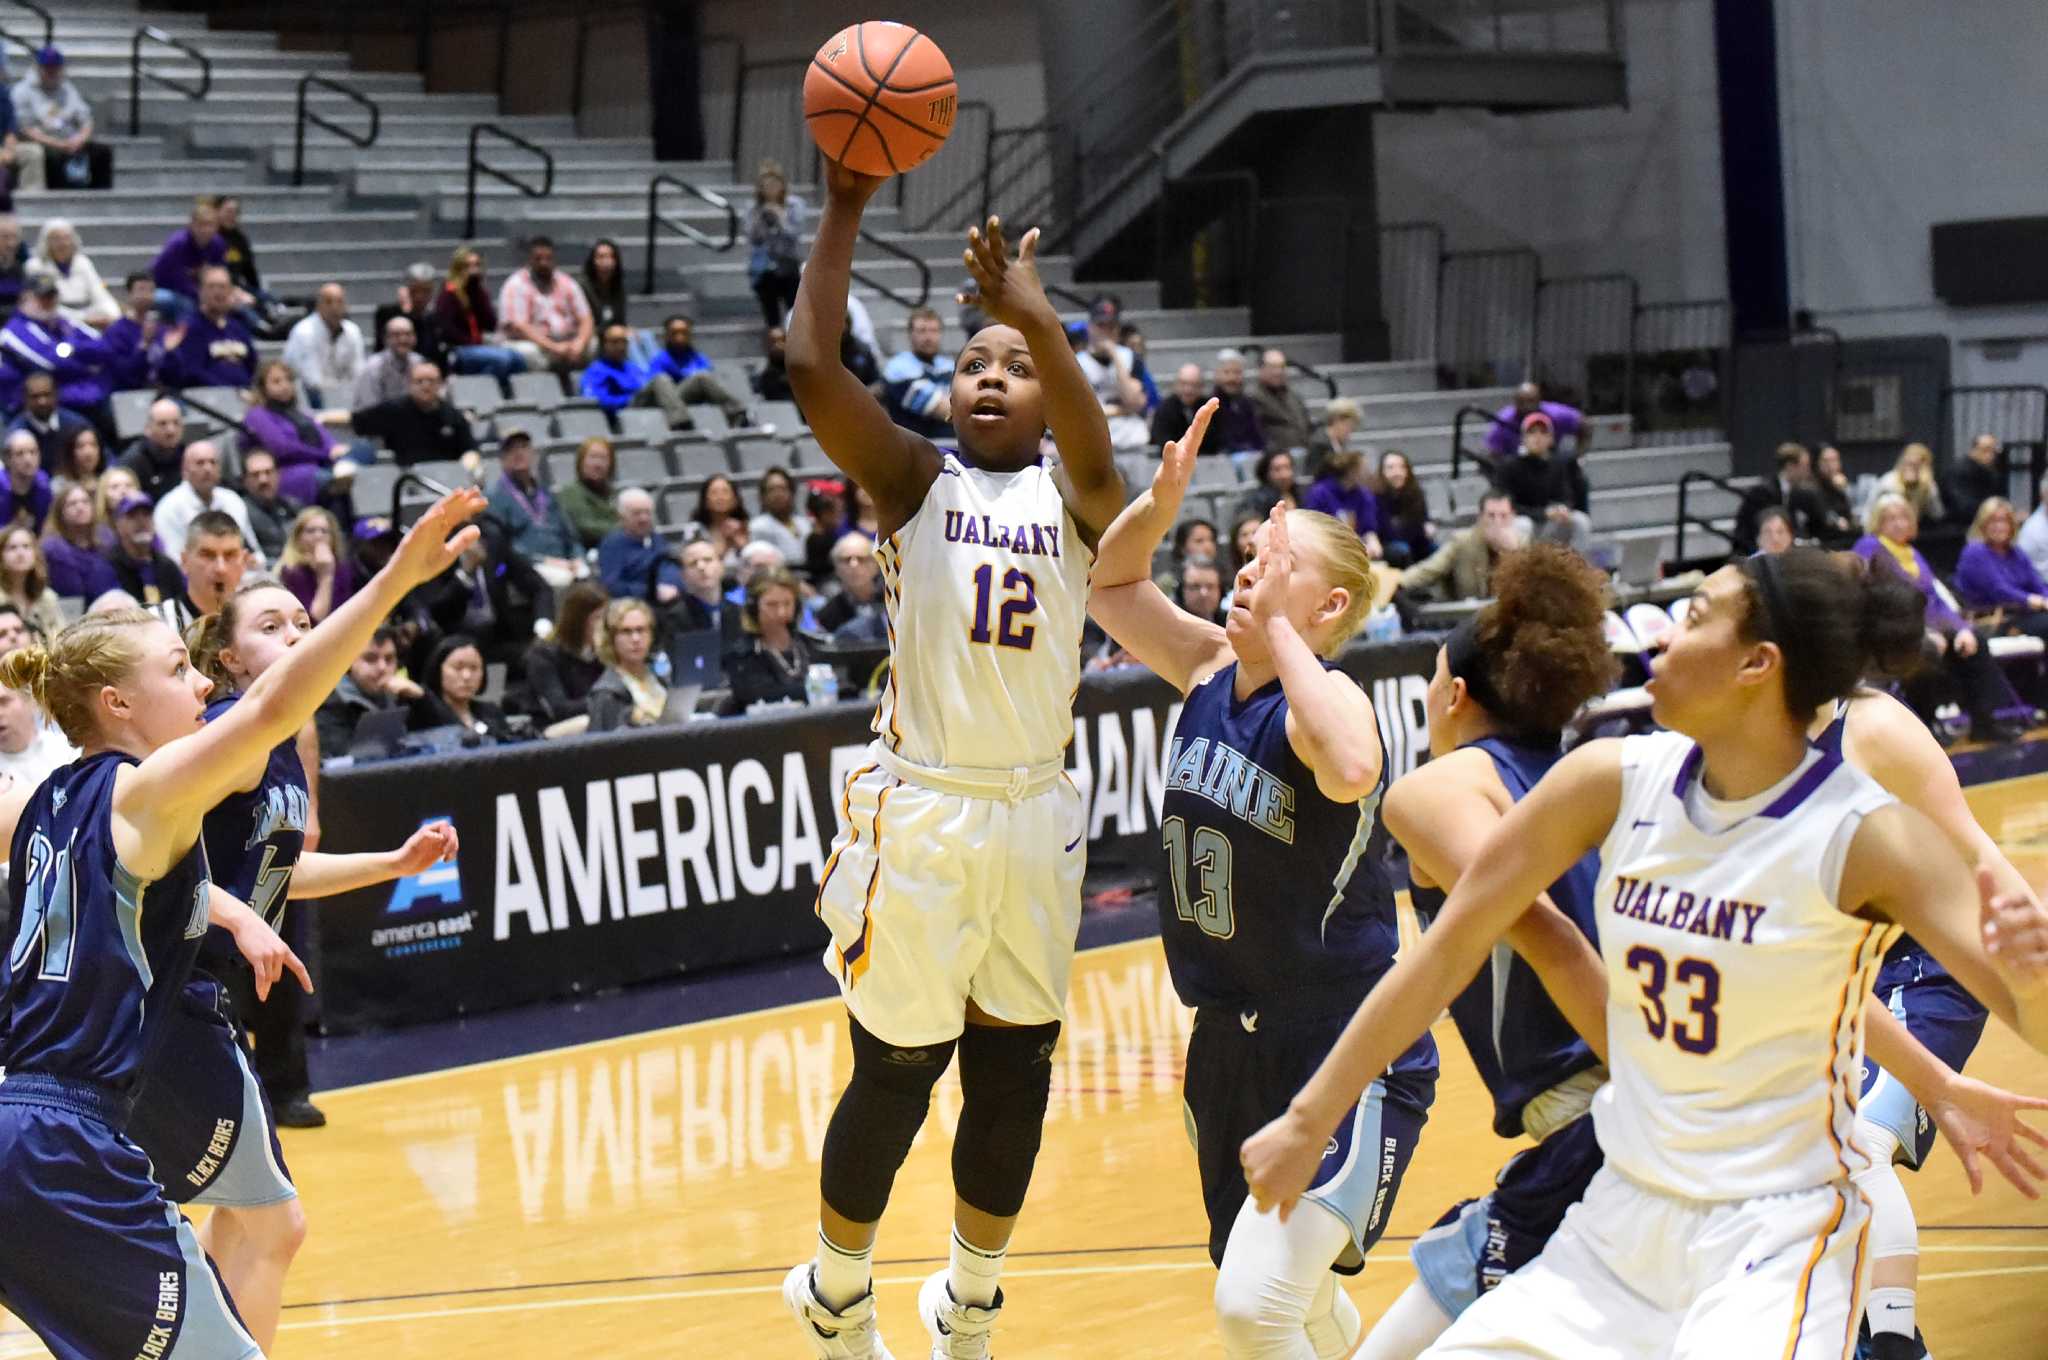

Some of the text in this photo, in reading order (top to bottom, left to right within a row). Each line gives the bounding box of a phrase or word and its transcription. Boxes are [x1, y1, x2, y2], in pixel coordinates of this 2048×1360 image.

[970, 562, 1038, 651] 12
[493, 751, 828, 941] AMERICA
[1163, 815, 1235, 940] 13
[1612, 876, 1767, 944] UALBANY
[1625, 944, 1722, 1057] 33
[186, 1118, 235, 1188] BLACK BEARS
[1380, 1137, 1397, 1184] BLACK
[155, 1271, 179, 1323] BEARS
